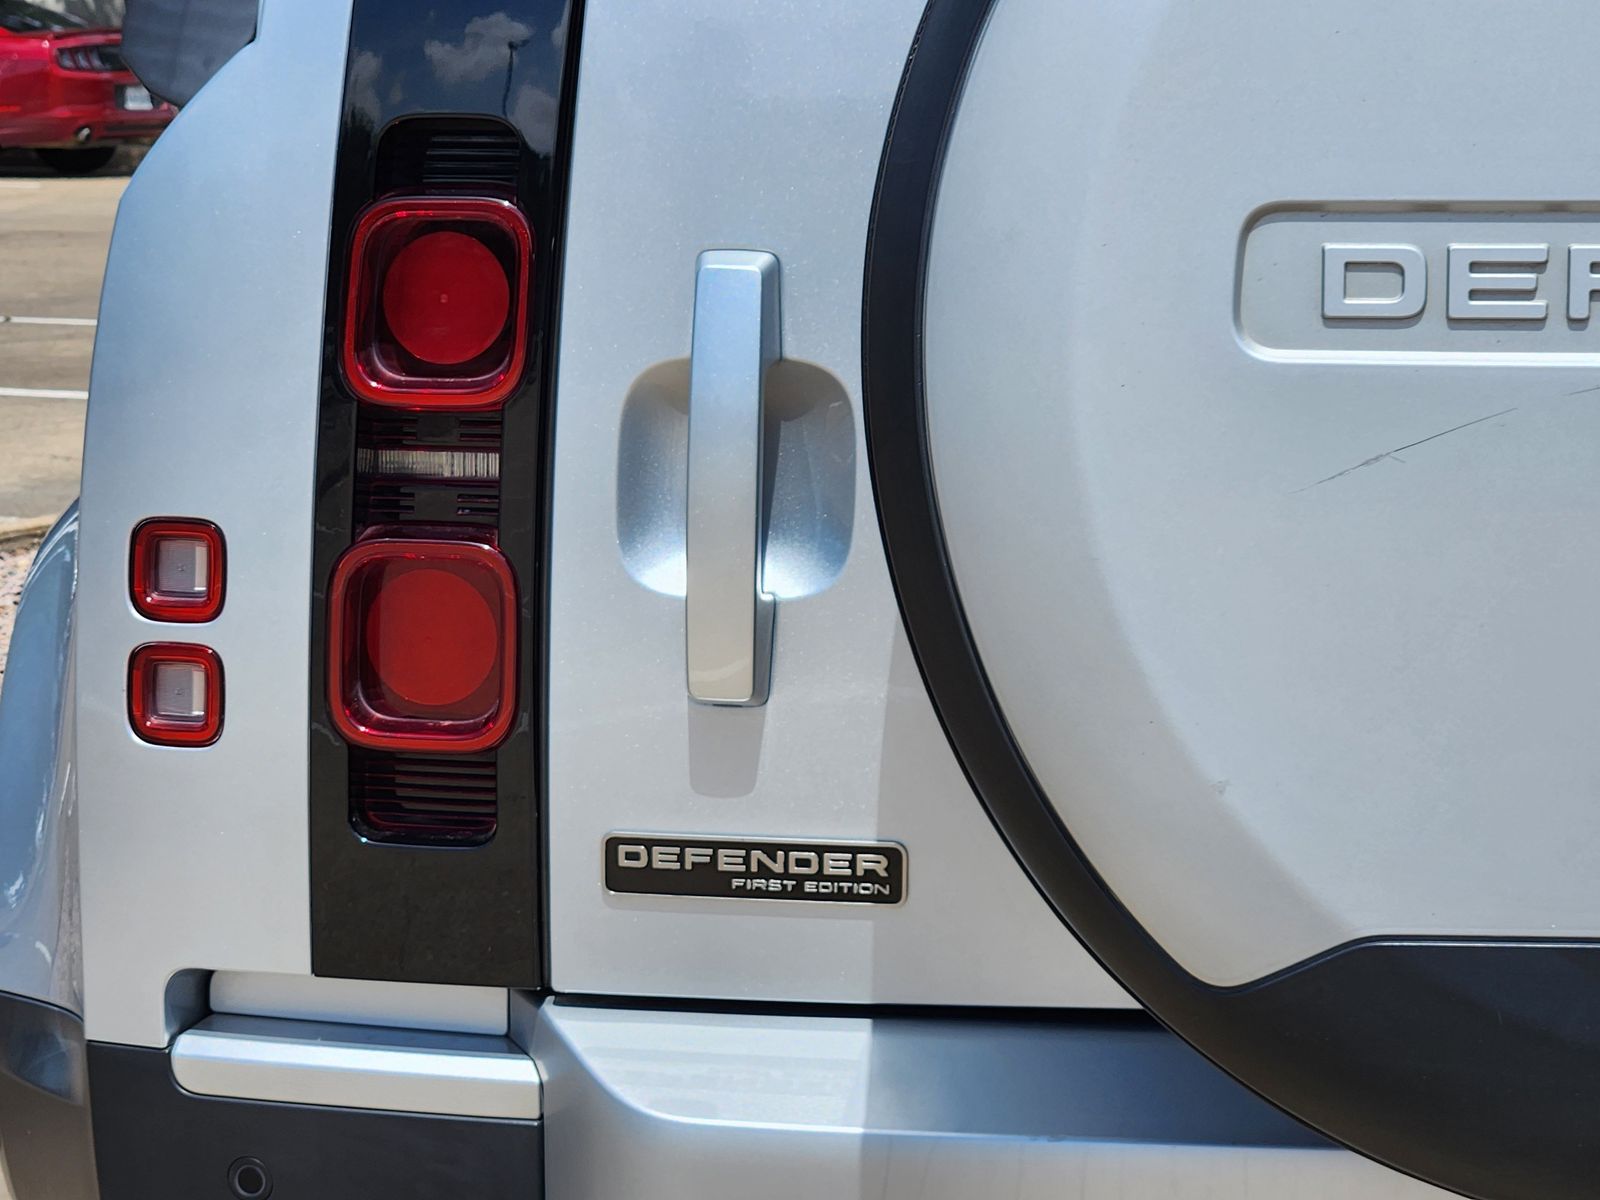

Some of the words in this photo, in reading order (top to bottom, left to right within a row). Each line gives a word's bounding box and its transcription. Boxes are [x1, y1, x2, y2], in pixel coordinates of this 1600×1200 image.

[617, 844, 889, 877] DEFENDER
[731, 878, 797, 892] FIRST
[804, 880, 890, 895] EDITION
